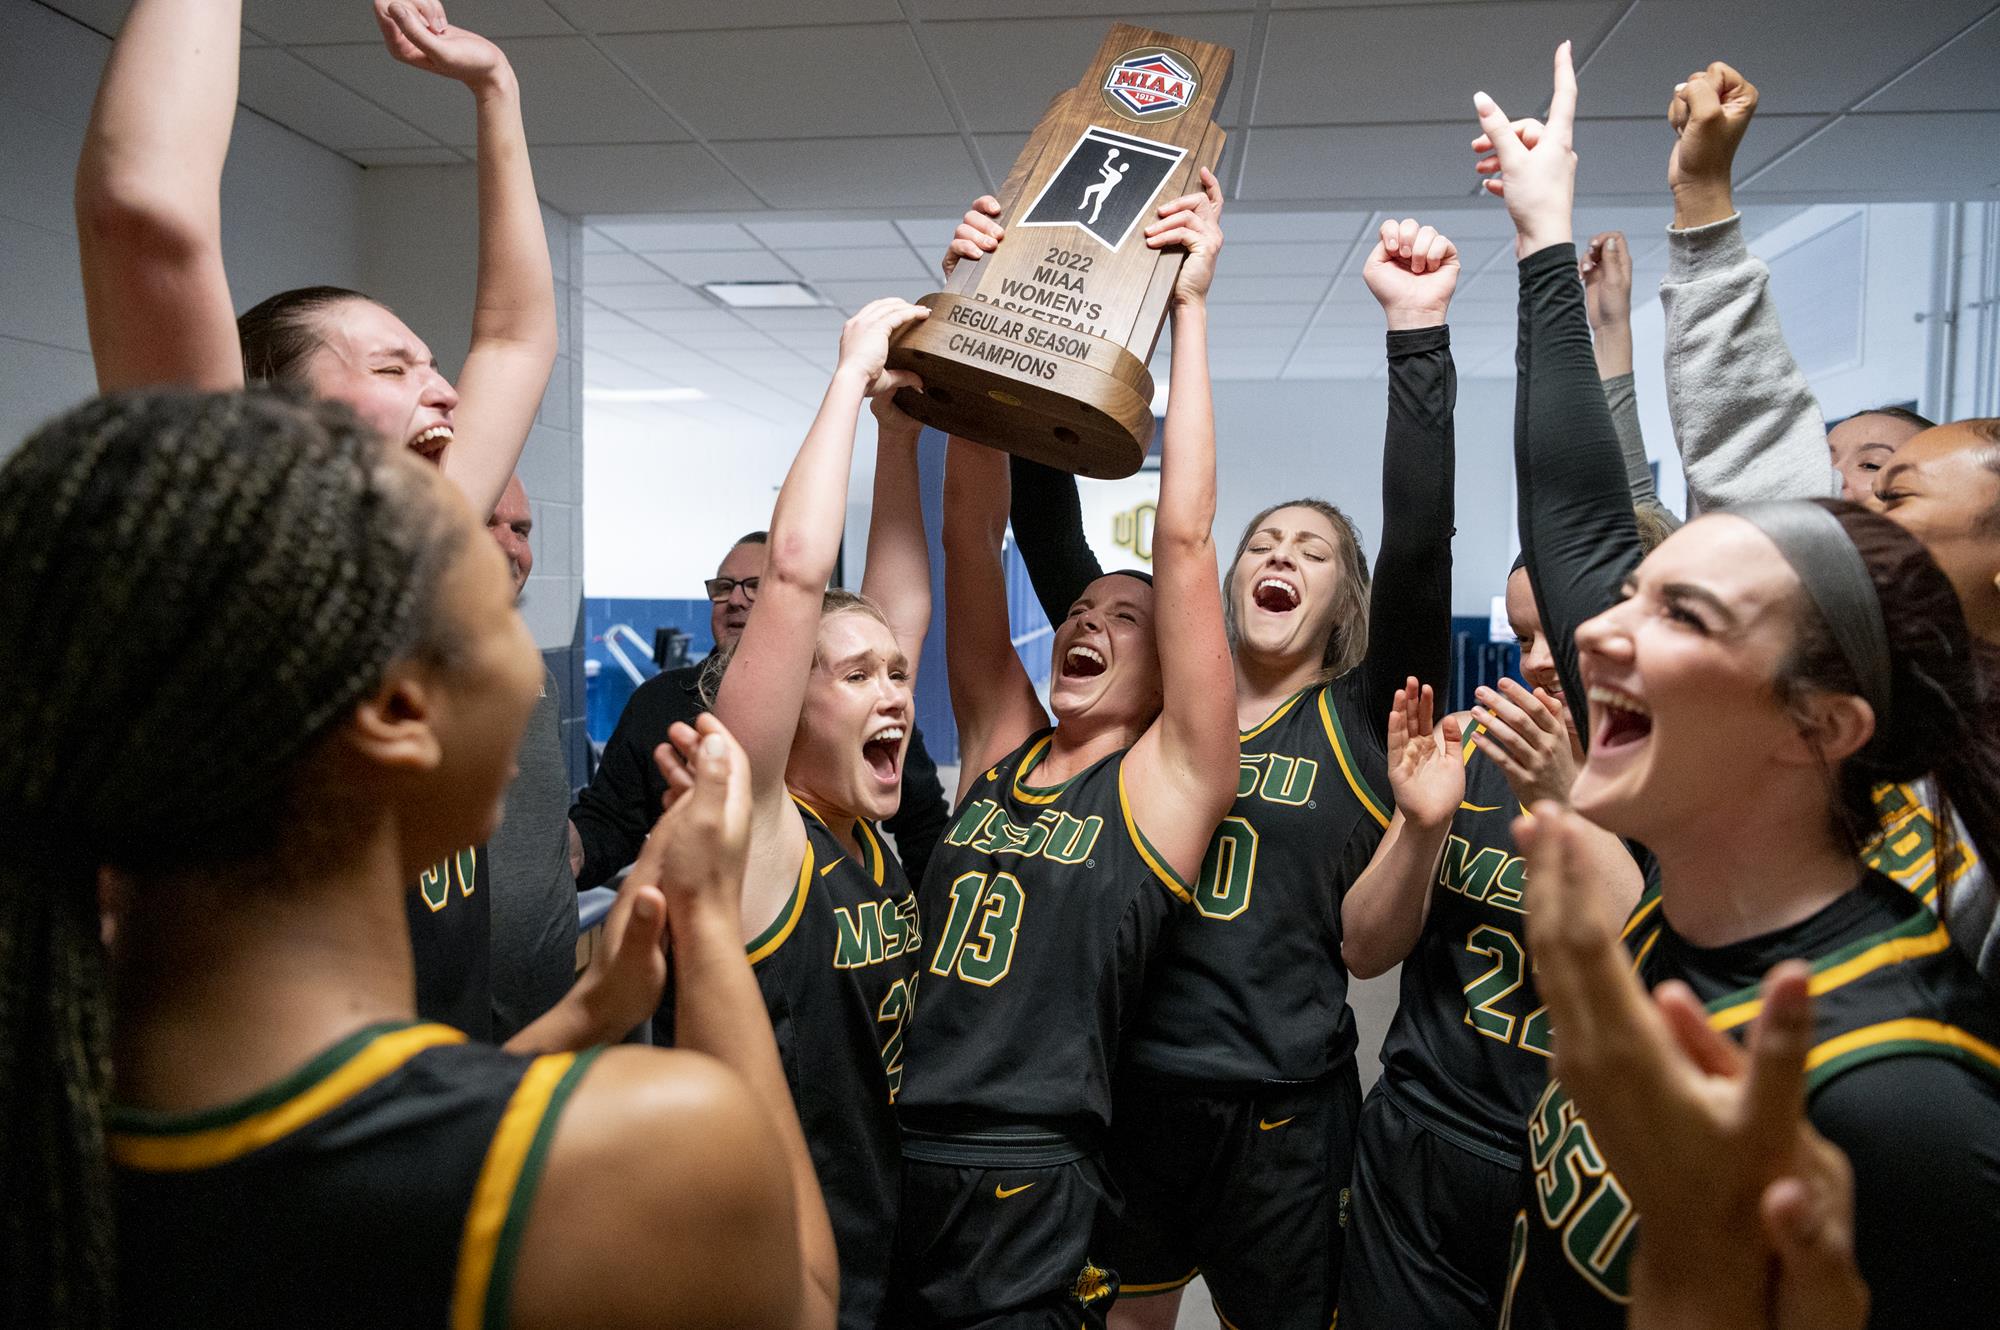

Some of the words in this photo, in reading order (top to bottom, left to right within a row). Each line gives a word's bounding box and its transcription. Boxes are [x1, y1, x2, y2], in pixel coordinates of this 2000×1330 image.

[1114, 70, 1184, 100] MIAA
[1135, 92, 1156, 102] 1912
[1044, 247, 1094, 273] 2022
[1032, 265, 1085, 294] MIAA
[948, 304, 1024, 340] REGULAR
[1024, 326, 1091, 361] SEASON
[948, 333, 1058, 380] CHAMPIONS
[930, 870, 1026, 987] 13
